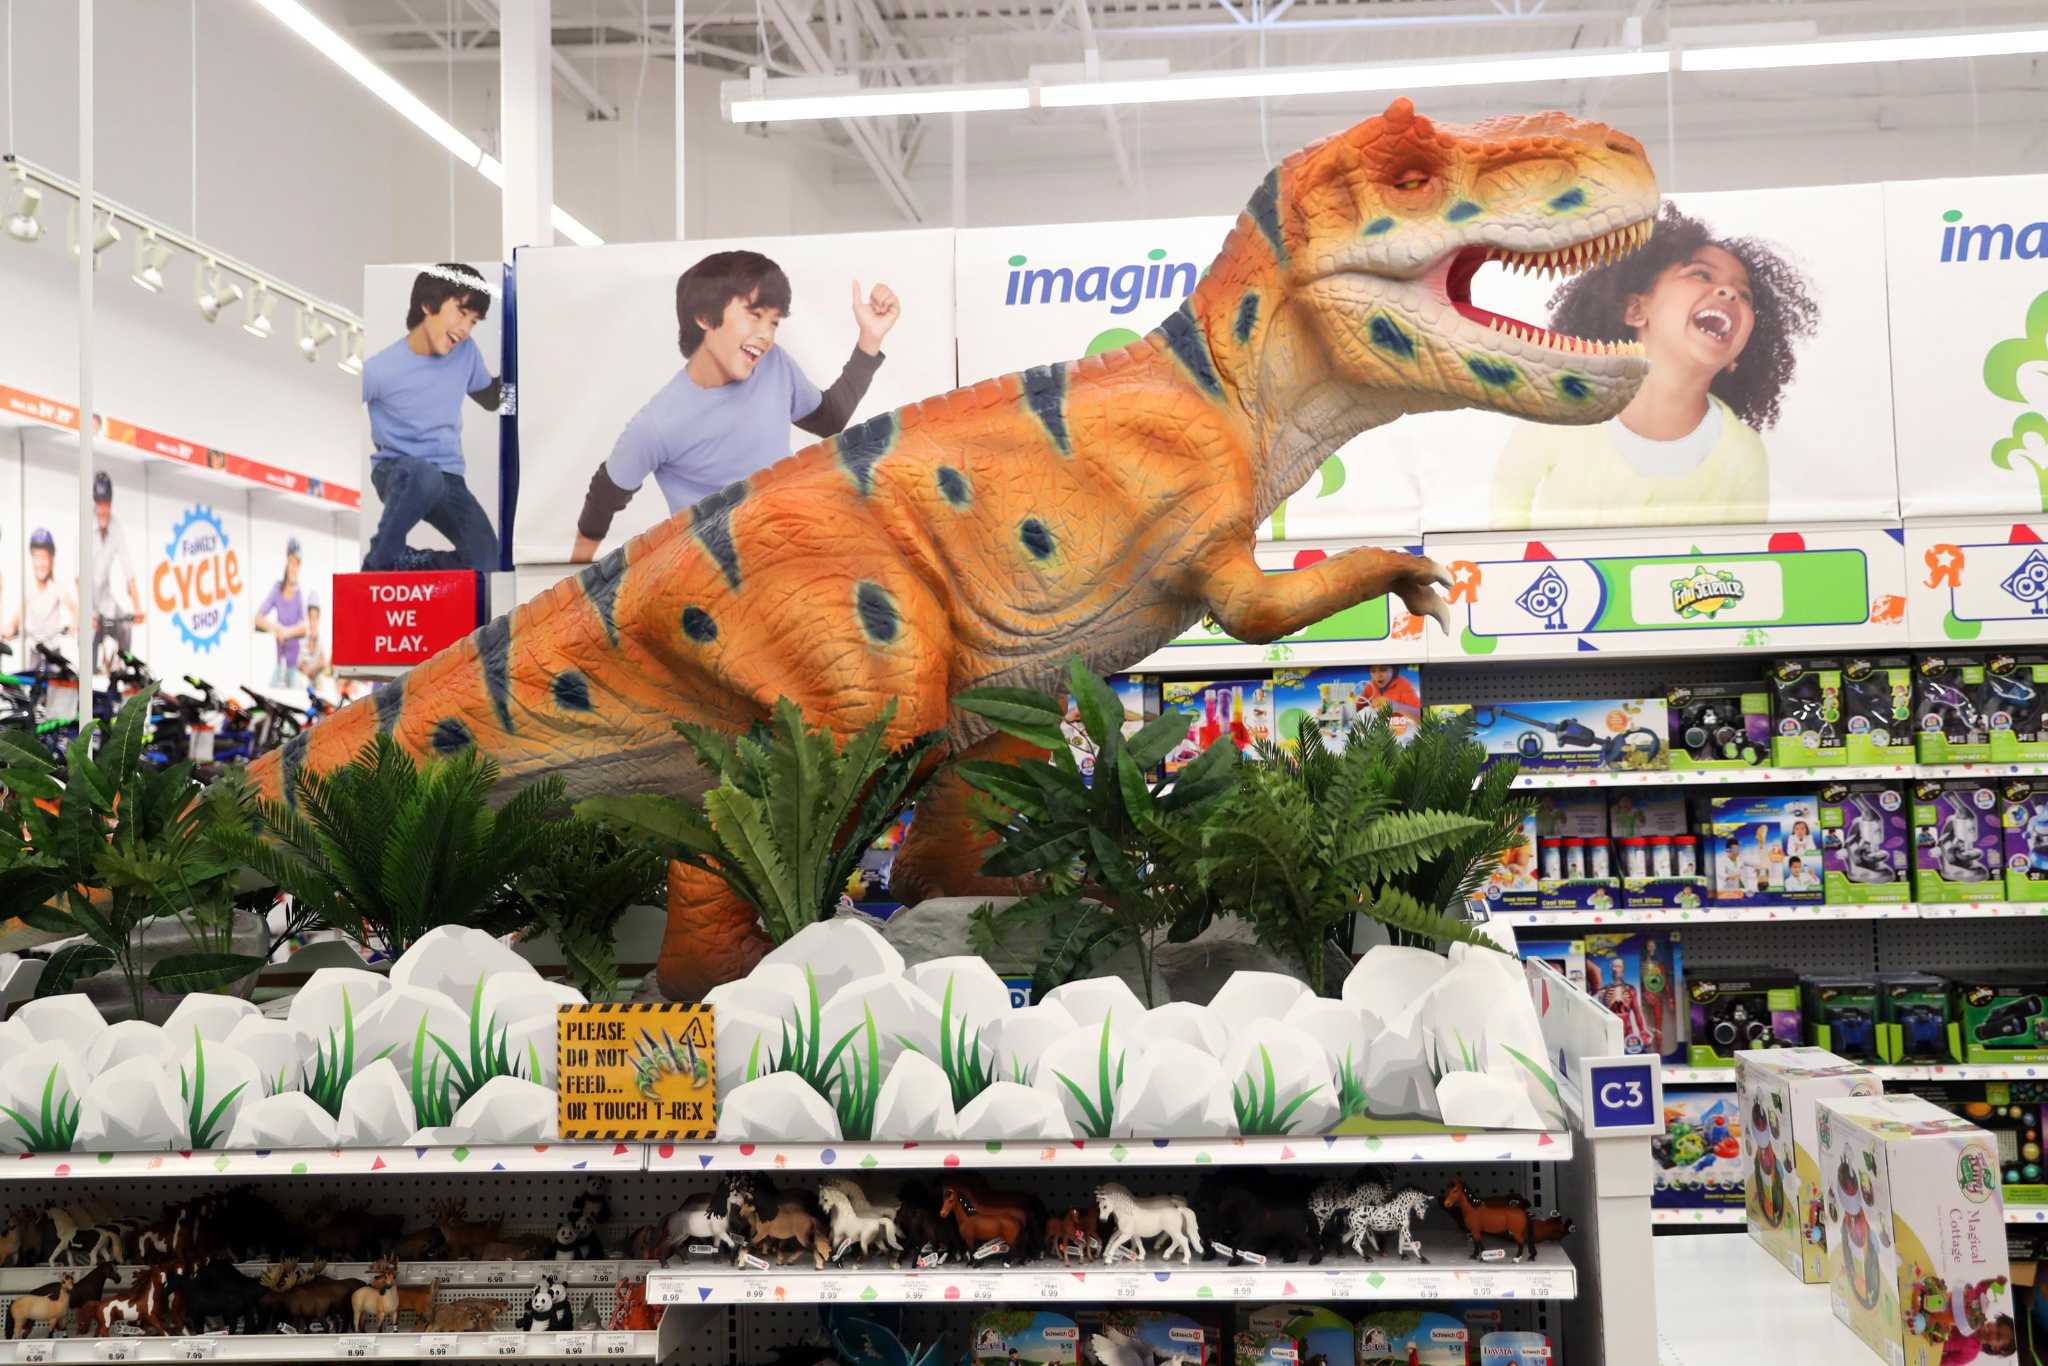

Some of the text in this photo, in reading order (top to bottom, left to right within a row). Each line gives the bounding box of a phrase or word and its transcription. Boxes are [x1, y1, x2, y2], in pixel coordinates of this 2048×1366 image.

[1005, 249, 1199, 315] imagin
[369, 585, 434, 602] TODAY
[386, 610, 417, 627] WE
[375, 635, 428, 652] PLAY.
[566, 1022, 626, 1041] PLEASE
[566, 1048, 629, 1067] DO NOT
[566, 1075, 624, 1094] FEED...
[1600, 1081, 1643, 1109] C3
[567, 1101, 704, 1121] OR TOUCH T-REX
[1949, 1208, 1963, 1264] Cottage
[1967, 1209, 1986, 1264] Magical
